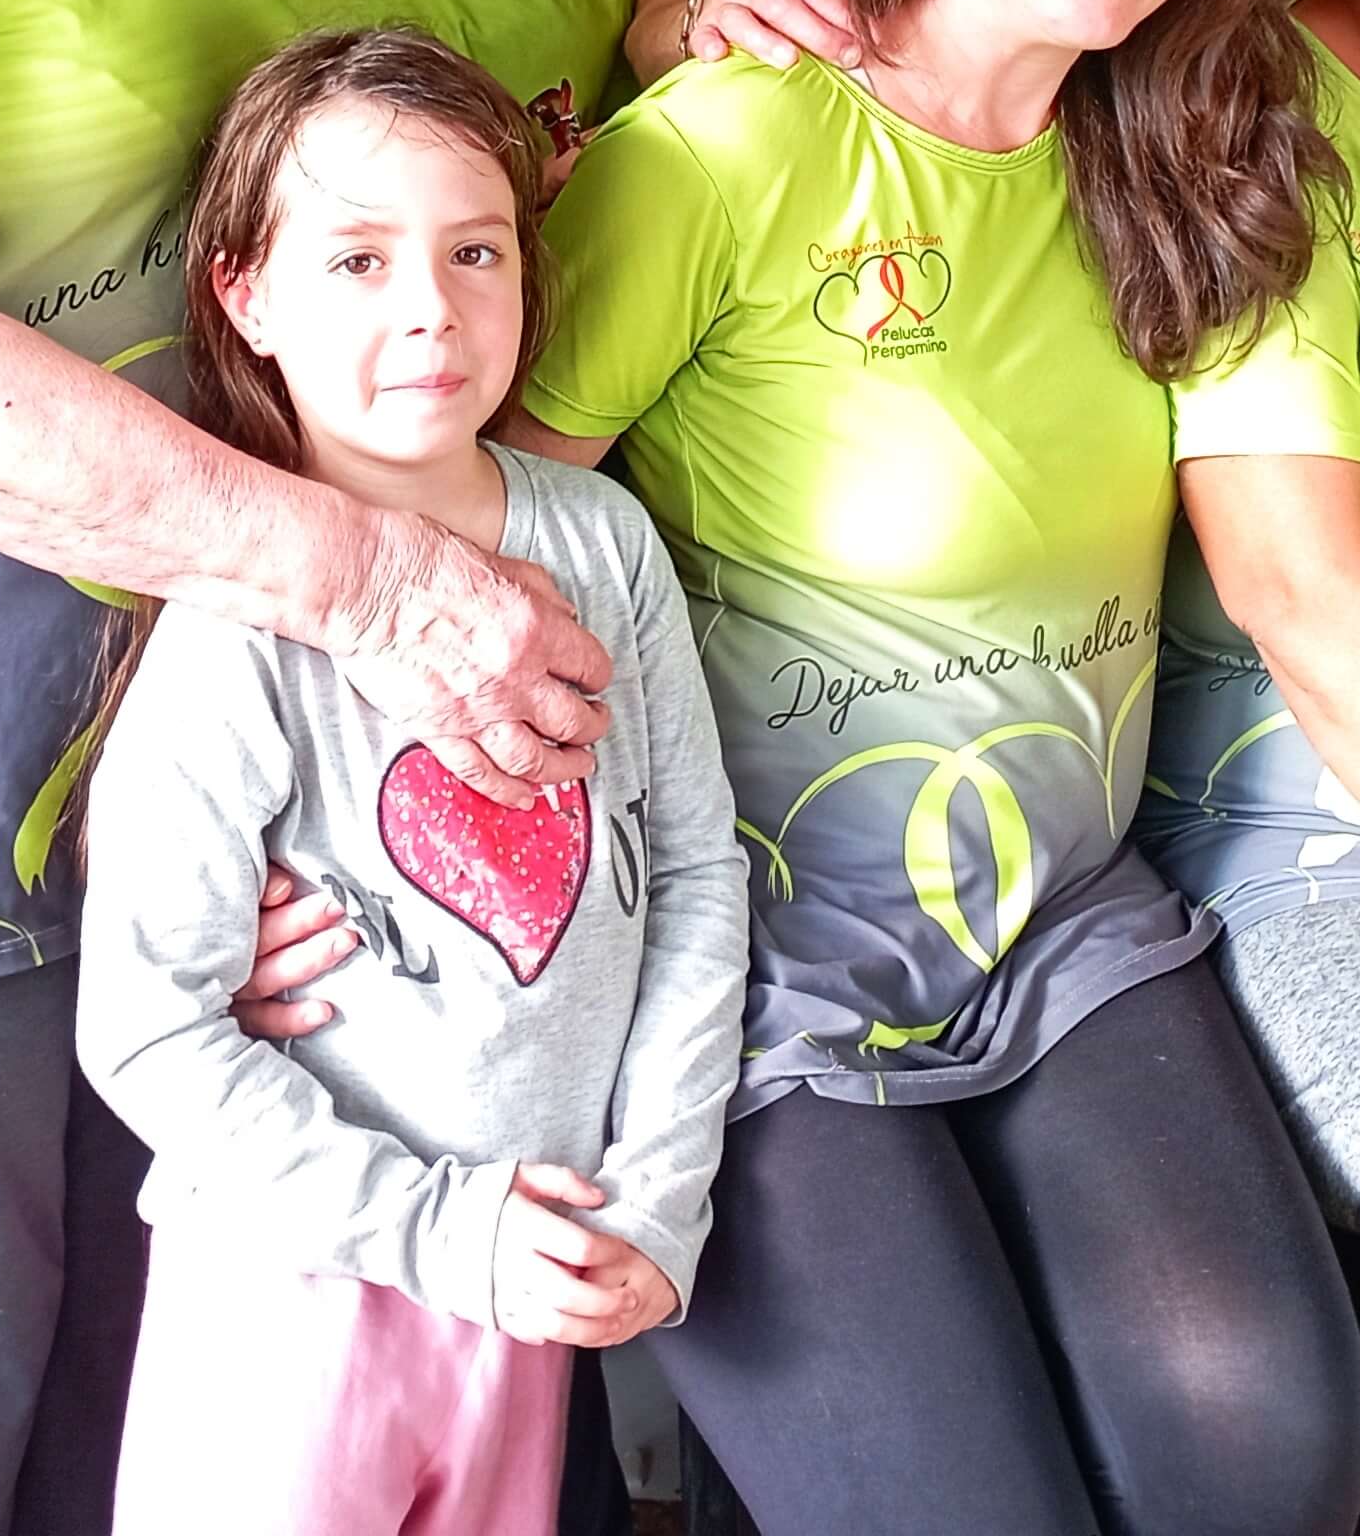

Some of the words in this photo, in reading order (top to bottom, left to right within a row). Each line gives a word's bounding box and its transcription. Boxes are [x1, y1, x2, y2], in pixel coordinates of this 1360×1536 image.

[24, 267, 127, 329] una
[871, 339, 948, 360] Pergamino
[881, 325, 935, 343] Pelucas
[767, 657, 920, 734] Dejar
[934, 646, 1019, 683] una
[1032, 594, 1139, 673] huella
